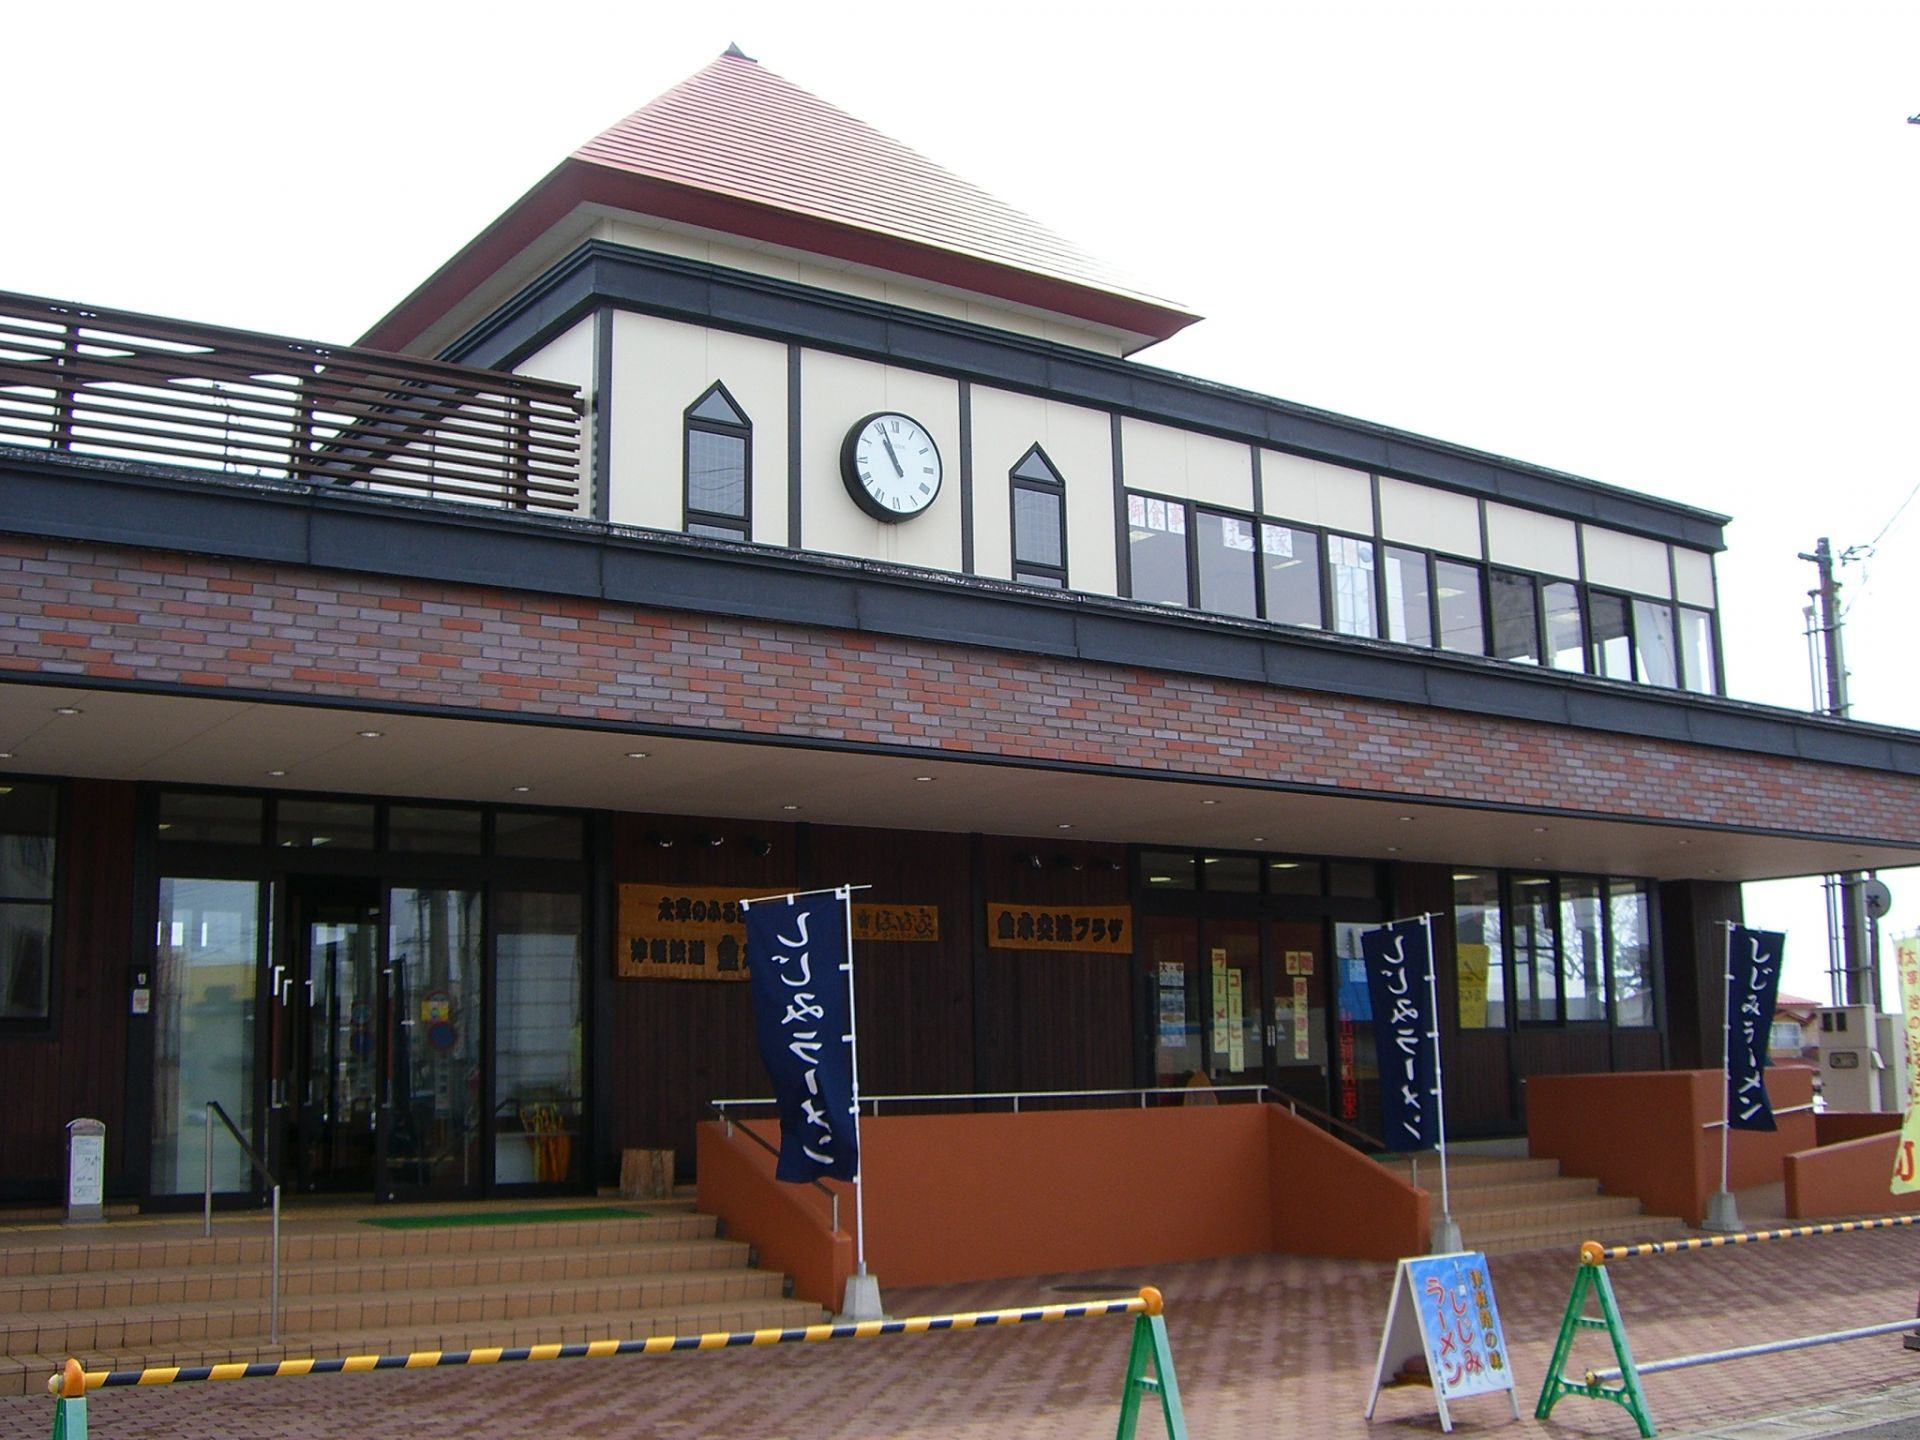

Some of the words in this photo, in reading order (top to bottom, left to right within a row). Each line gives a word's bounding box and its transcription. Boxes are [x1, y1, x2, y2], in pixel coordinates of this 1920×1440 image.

[1214, 952, 1226, 1046] ラーメン
[1230, 974, 1241, 1066] コーヒー
[1736, 936, 1774, 1122] しじみラーメン
[1425, 1276, 1463, 1389] ラーメン
[1449, 1288, 1484, 1377] しじみ
